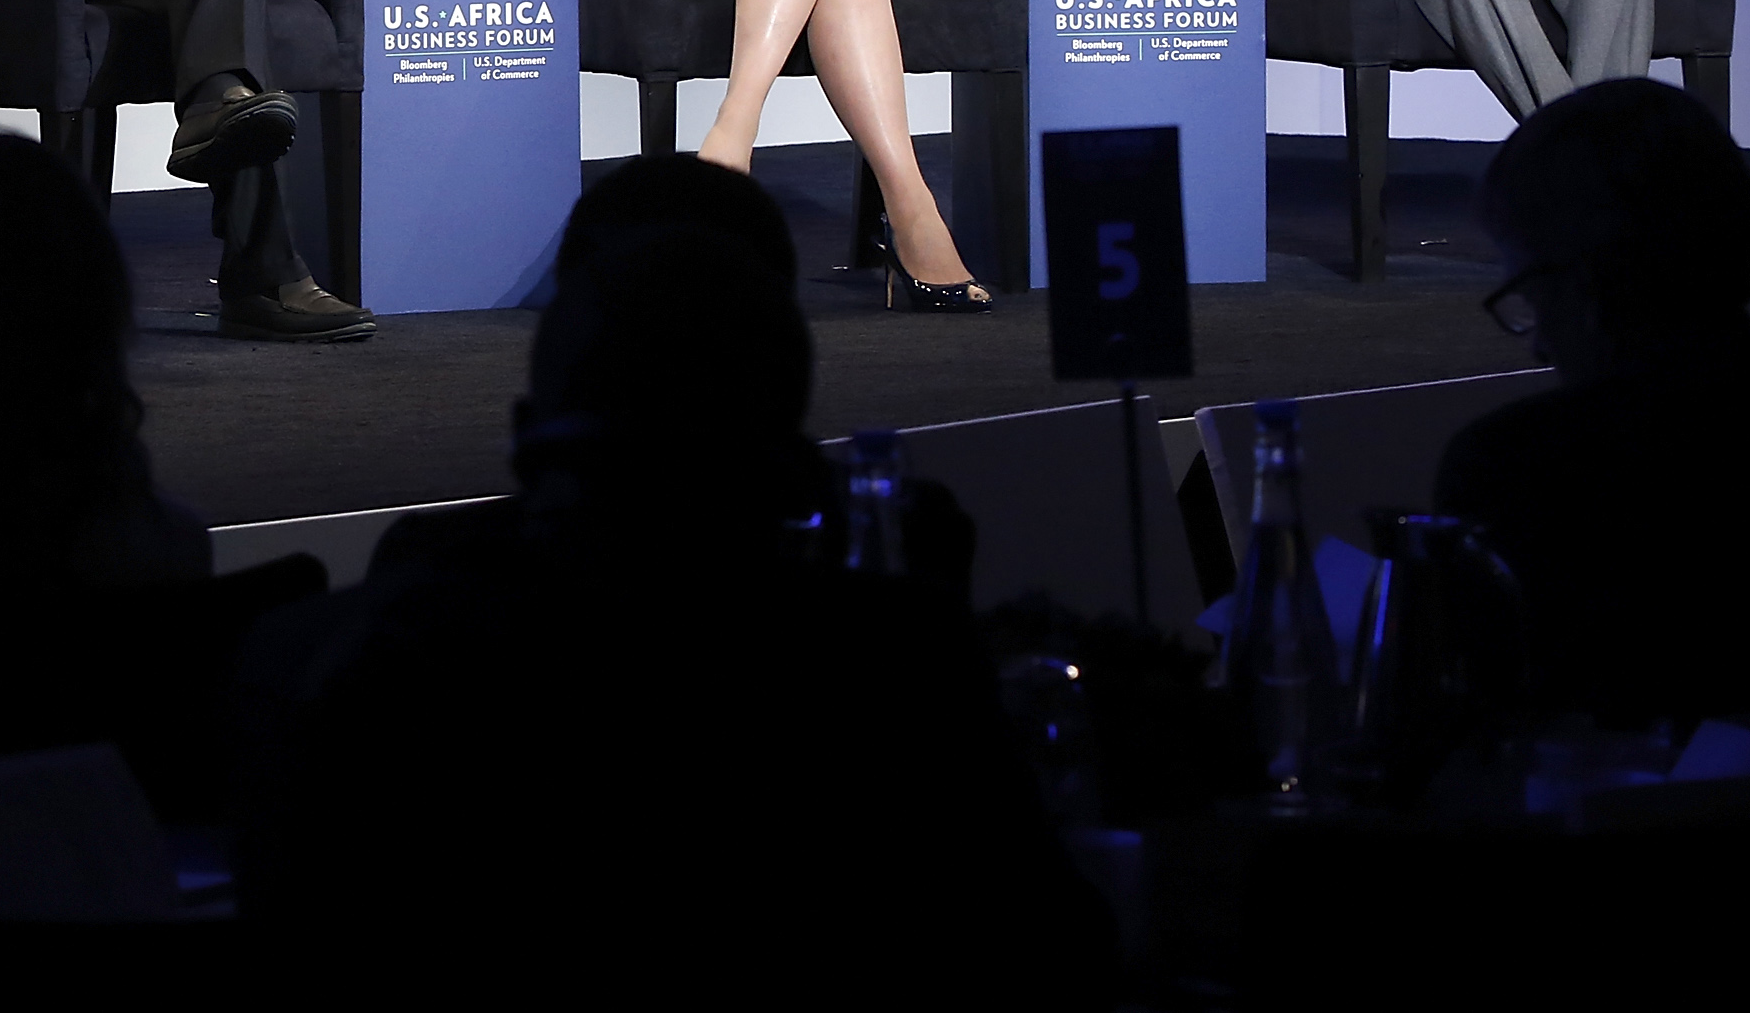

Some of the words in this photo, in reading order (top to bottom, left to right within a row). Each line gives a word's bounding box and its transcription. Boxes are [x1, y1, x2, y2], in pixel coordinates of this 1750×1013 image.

[383, 5, 439, 30] U.S.
[448, 1, 554, 27] AFRICA
[1055, 12, 1156, 30] BUSINESS
[1163, 11, 1238, 28] FORUM
[384, 31, 478, 50] BUSINESS
[485, 28, 555, 47] FORUM
[1072, 39, 1123, 51] Bloomberg
[1173, 37, 1228, 49] Department
[1065, 52, 1130, 64] Philanthropies
[1158, 51, 1169, 61] of
[1170, 50, 1221, 61] Commerce
[400, 59, 448, 71] Bloomberg
[494, 56, 546, 68] Department
[393, 72, 455, 85] Philanthropies
[481, 70, 491, 81] of
[492, 69, 540, 80] Commerce
[1097, 222, 1141, 301] 5
